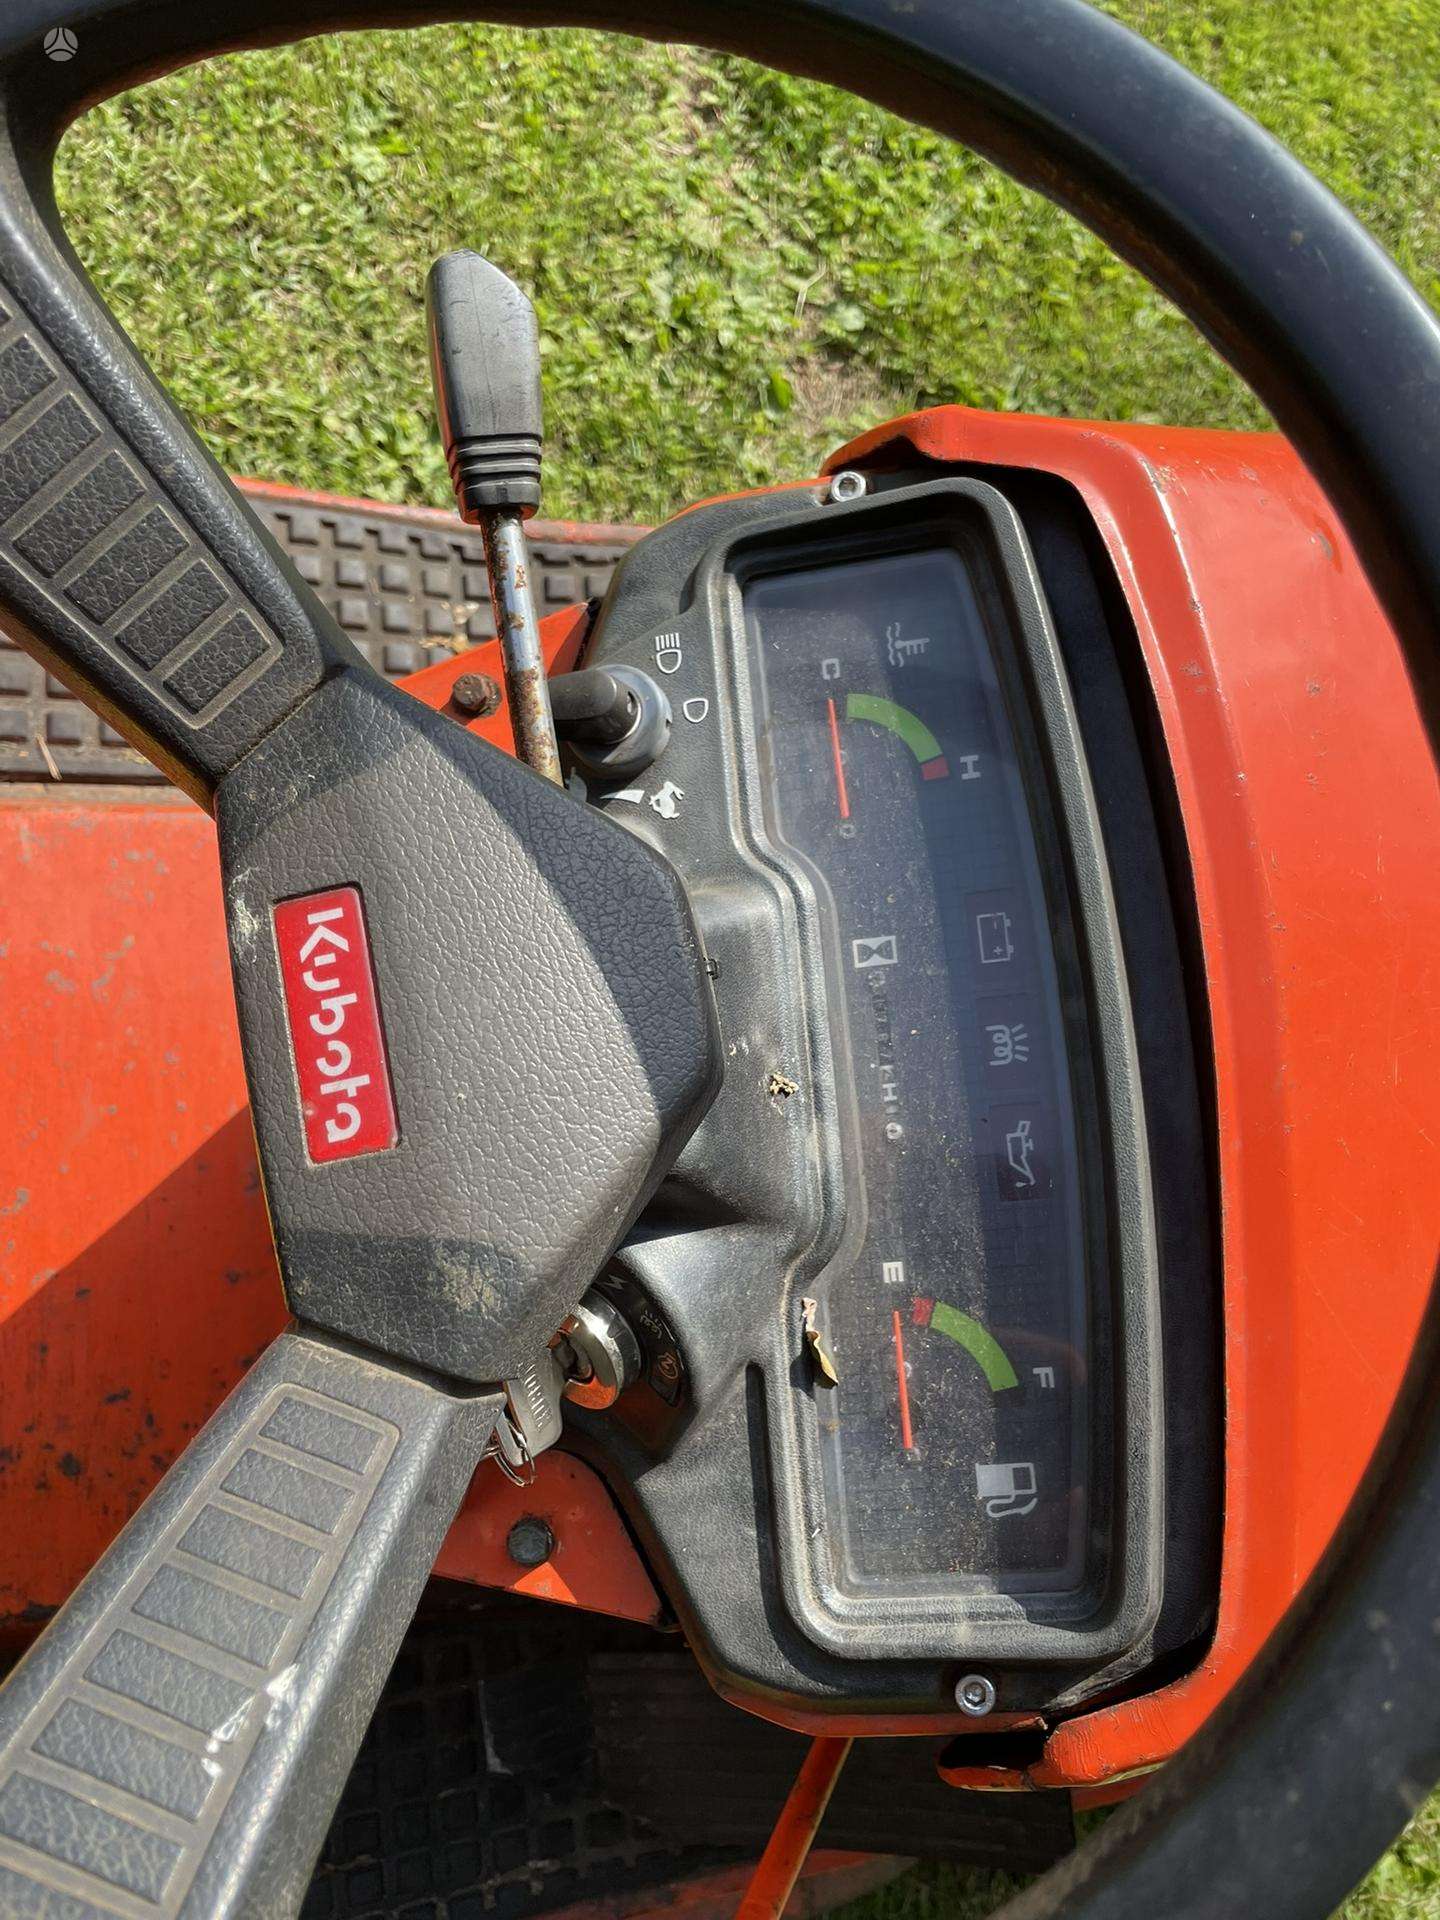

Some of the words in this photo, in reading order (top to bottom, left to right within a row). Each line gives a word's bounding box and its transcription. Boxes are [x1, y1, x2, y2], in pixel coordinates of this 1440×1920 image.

[821, 658, 841, 680] C
[959, 754, 981, 780] H
[300, 907, 371, 1143] Kubota
[882, 1261, 904, 1284] E
[1032, 1366, 1056, 1389] F
